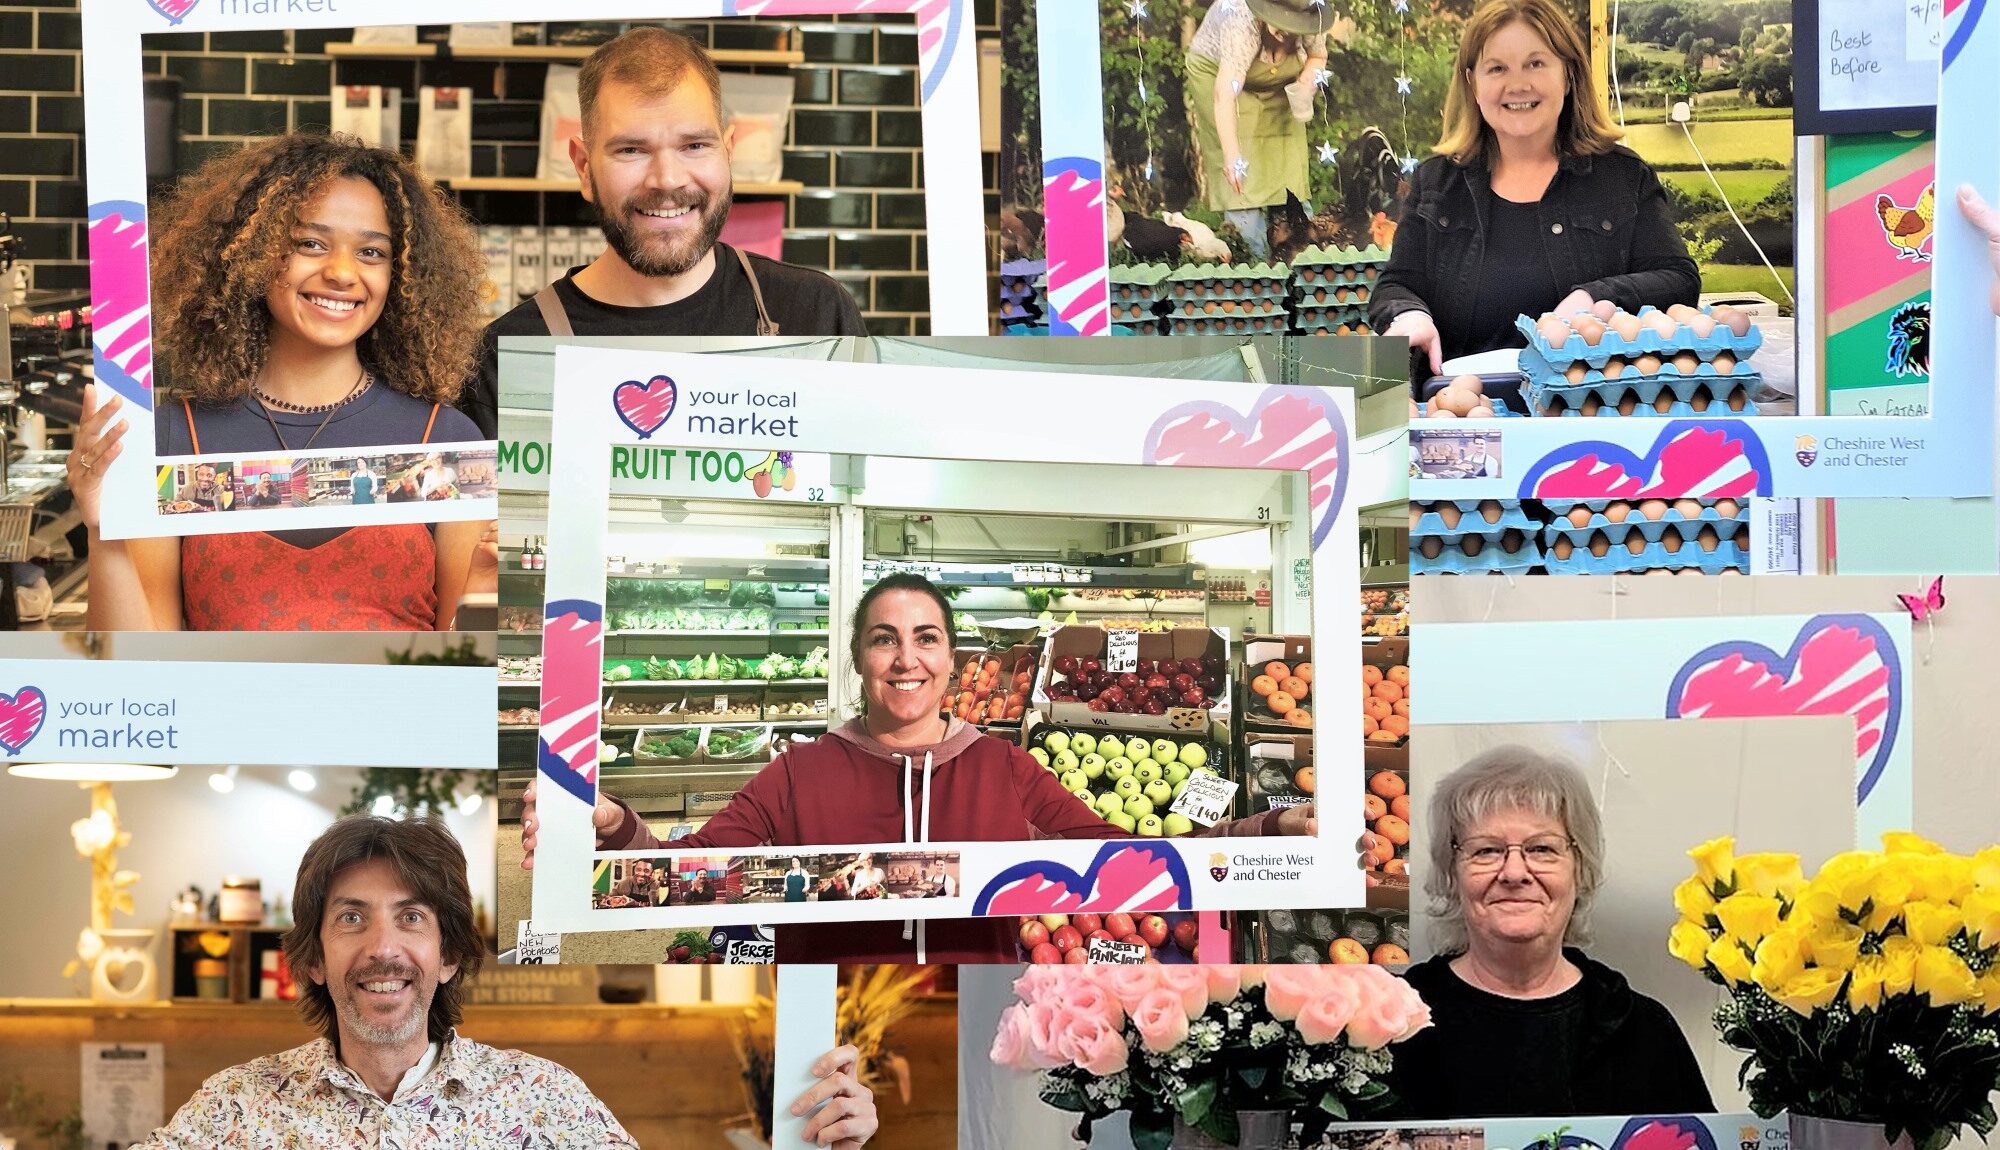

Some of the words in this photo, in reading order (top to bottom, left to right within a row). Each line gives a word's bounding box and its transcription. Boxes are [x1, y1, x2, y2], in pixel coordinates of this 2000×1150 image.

[1831, 29, 1872, 51] Best
[1831, 57, 1881, 82] Before
[689, 391, 739, 406] your
[747, 389, 796, 408] local
[688, 412, 799, 437] market
[1824, 437, 1886, 450] Cheshire
[1890, 436, 1925, 450] West
[498, 441, 551, 475] MO
[612, 446, 677, 481] RUIT
[686, 450, 745, 482] TOO
[1823, 454, 1850, 467] and
[1855, 453, 1909, 467] Chester
[808, 487, 825, 502] 32
[1257, 507, 1270, 520] 31
[60, 702, 113, 719] your
[122, 698, 176, 716] local
[1092, 718, 1110, 726] VAL
[59, 723, 178, 749] market
[1190, 778, 1230, 796] GOLDEN
[1203, 774, 1227, 786] SWEET
[1187, 785, 1225, 802] DELICIOUS
[1233, 855, 1283, 867] Cheshire
[1286, 855, 1315, 866] West
[1233, 869, 1255, 881] and
[1258, 869, 1302, 881] Chester
[520, 937, 543, 948] NEW
[730, 940, 774, 958] JERSE
[1098, 939, 1144, 954] SWEET
[1765, 1128, 1789, 1140] Che
